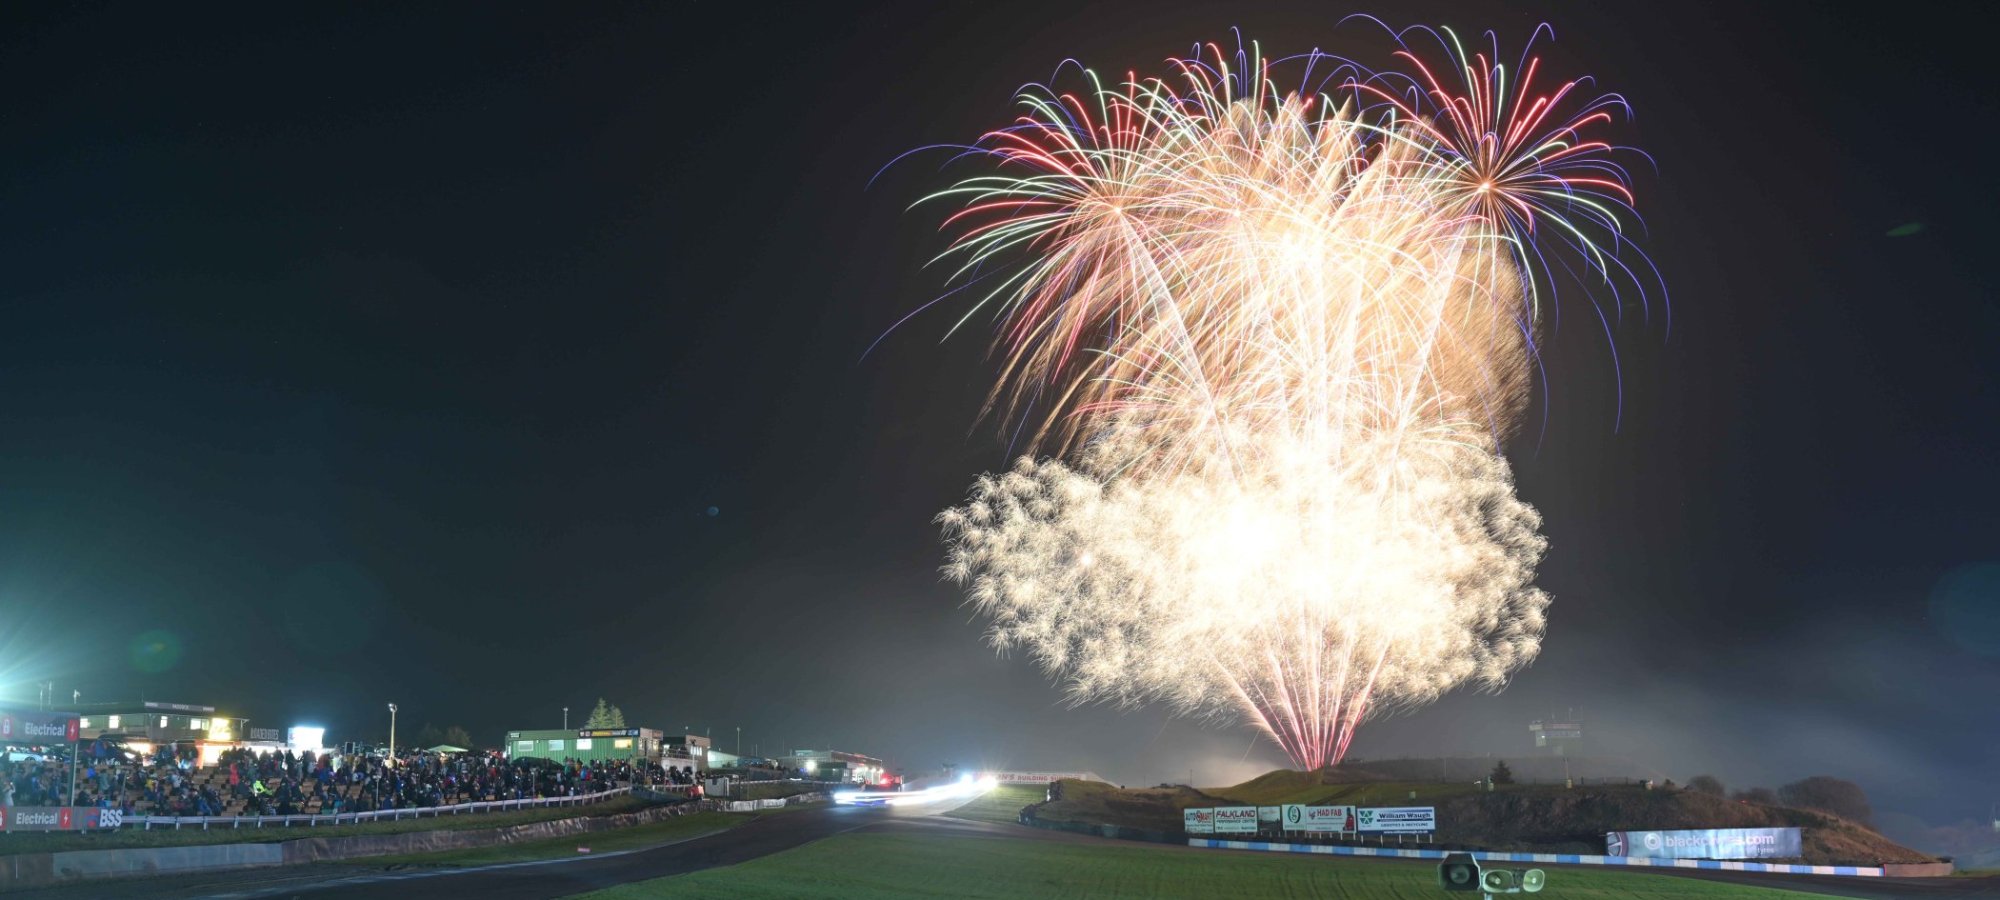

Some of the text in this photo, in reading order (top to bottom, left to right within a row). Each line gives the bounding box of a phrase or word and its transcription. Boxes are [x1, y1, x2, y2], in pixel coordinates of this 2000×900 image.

[25, 722, 65, 736] Electrical
[16, 812, 57, 825] Electrical
[100, 809, 122, 827] BSS
[1216, 809, 1255, 820] FALKLAND
[1317, 808, 1342, 817] HAD FAB
[1407, 812, 1430, 820] Waugh
